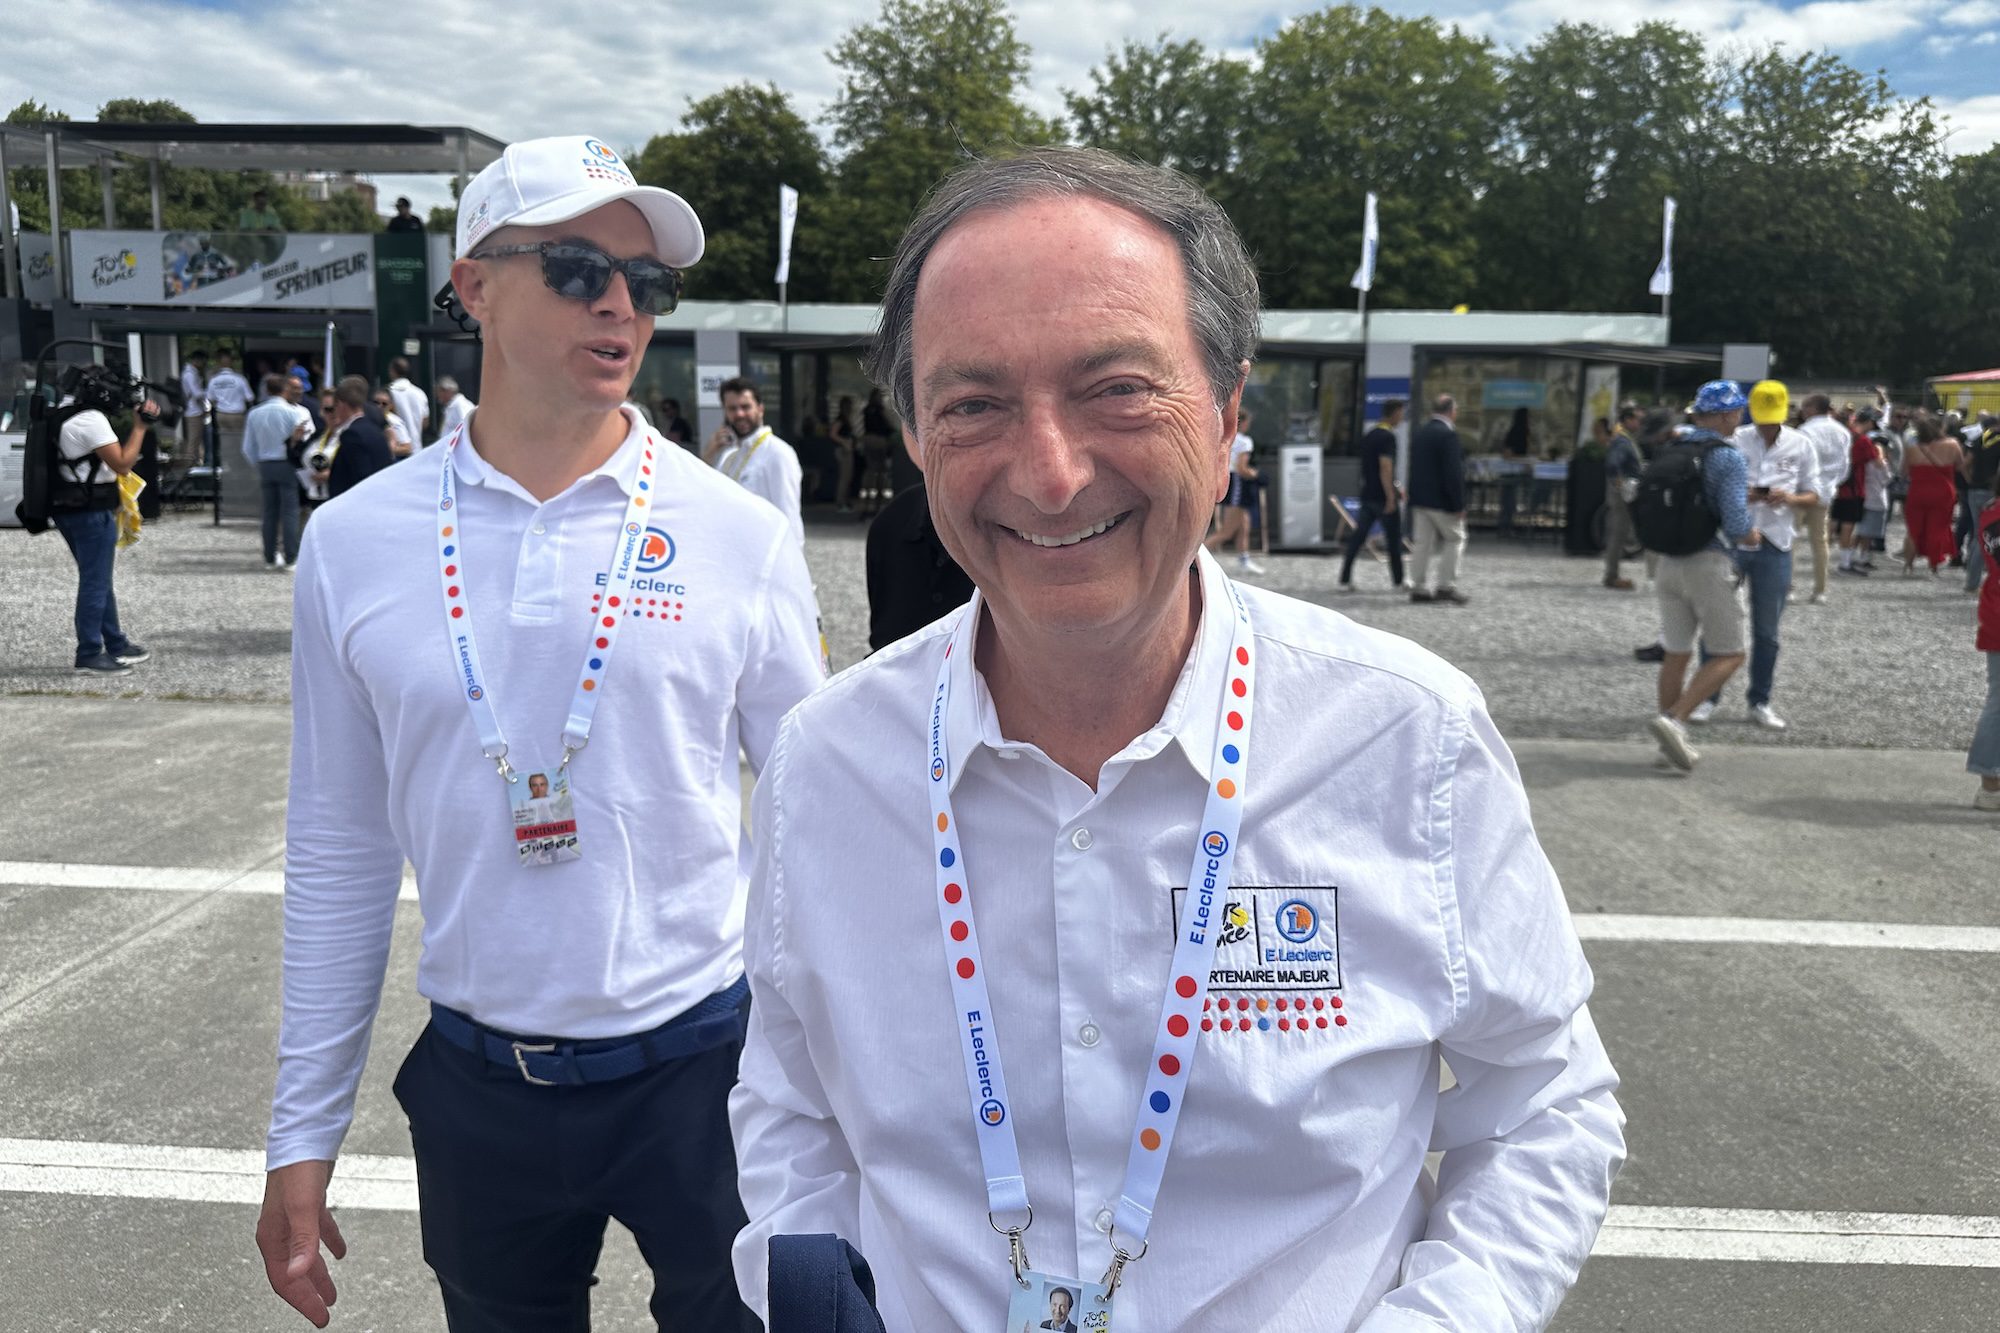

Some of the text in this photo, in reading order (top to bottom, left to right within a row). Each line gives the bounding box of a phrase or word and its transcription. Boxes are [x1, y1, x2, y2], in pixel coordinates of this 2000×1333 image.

[275, 251, 368, 300] SPRINTEUR
[595, 573, 686, 595] Eclerc
[1190, 858, 1219, 945] E.Leclerc
[1216, 927, 1250, 948] nce
[1265, 948, 1332, 962] E.Leclerc
[1209, 969, 1330, 983] RTENAIRE MAJEUR
[967, 1010, 993, 1098] E.Leclerc
